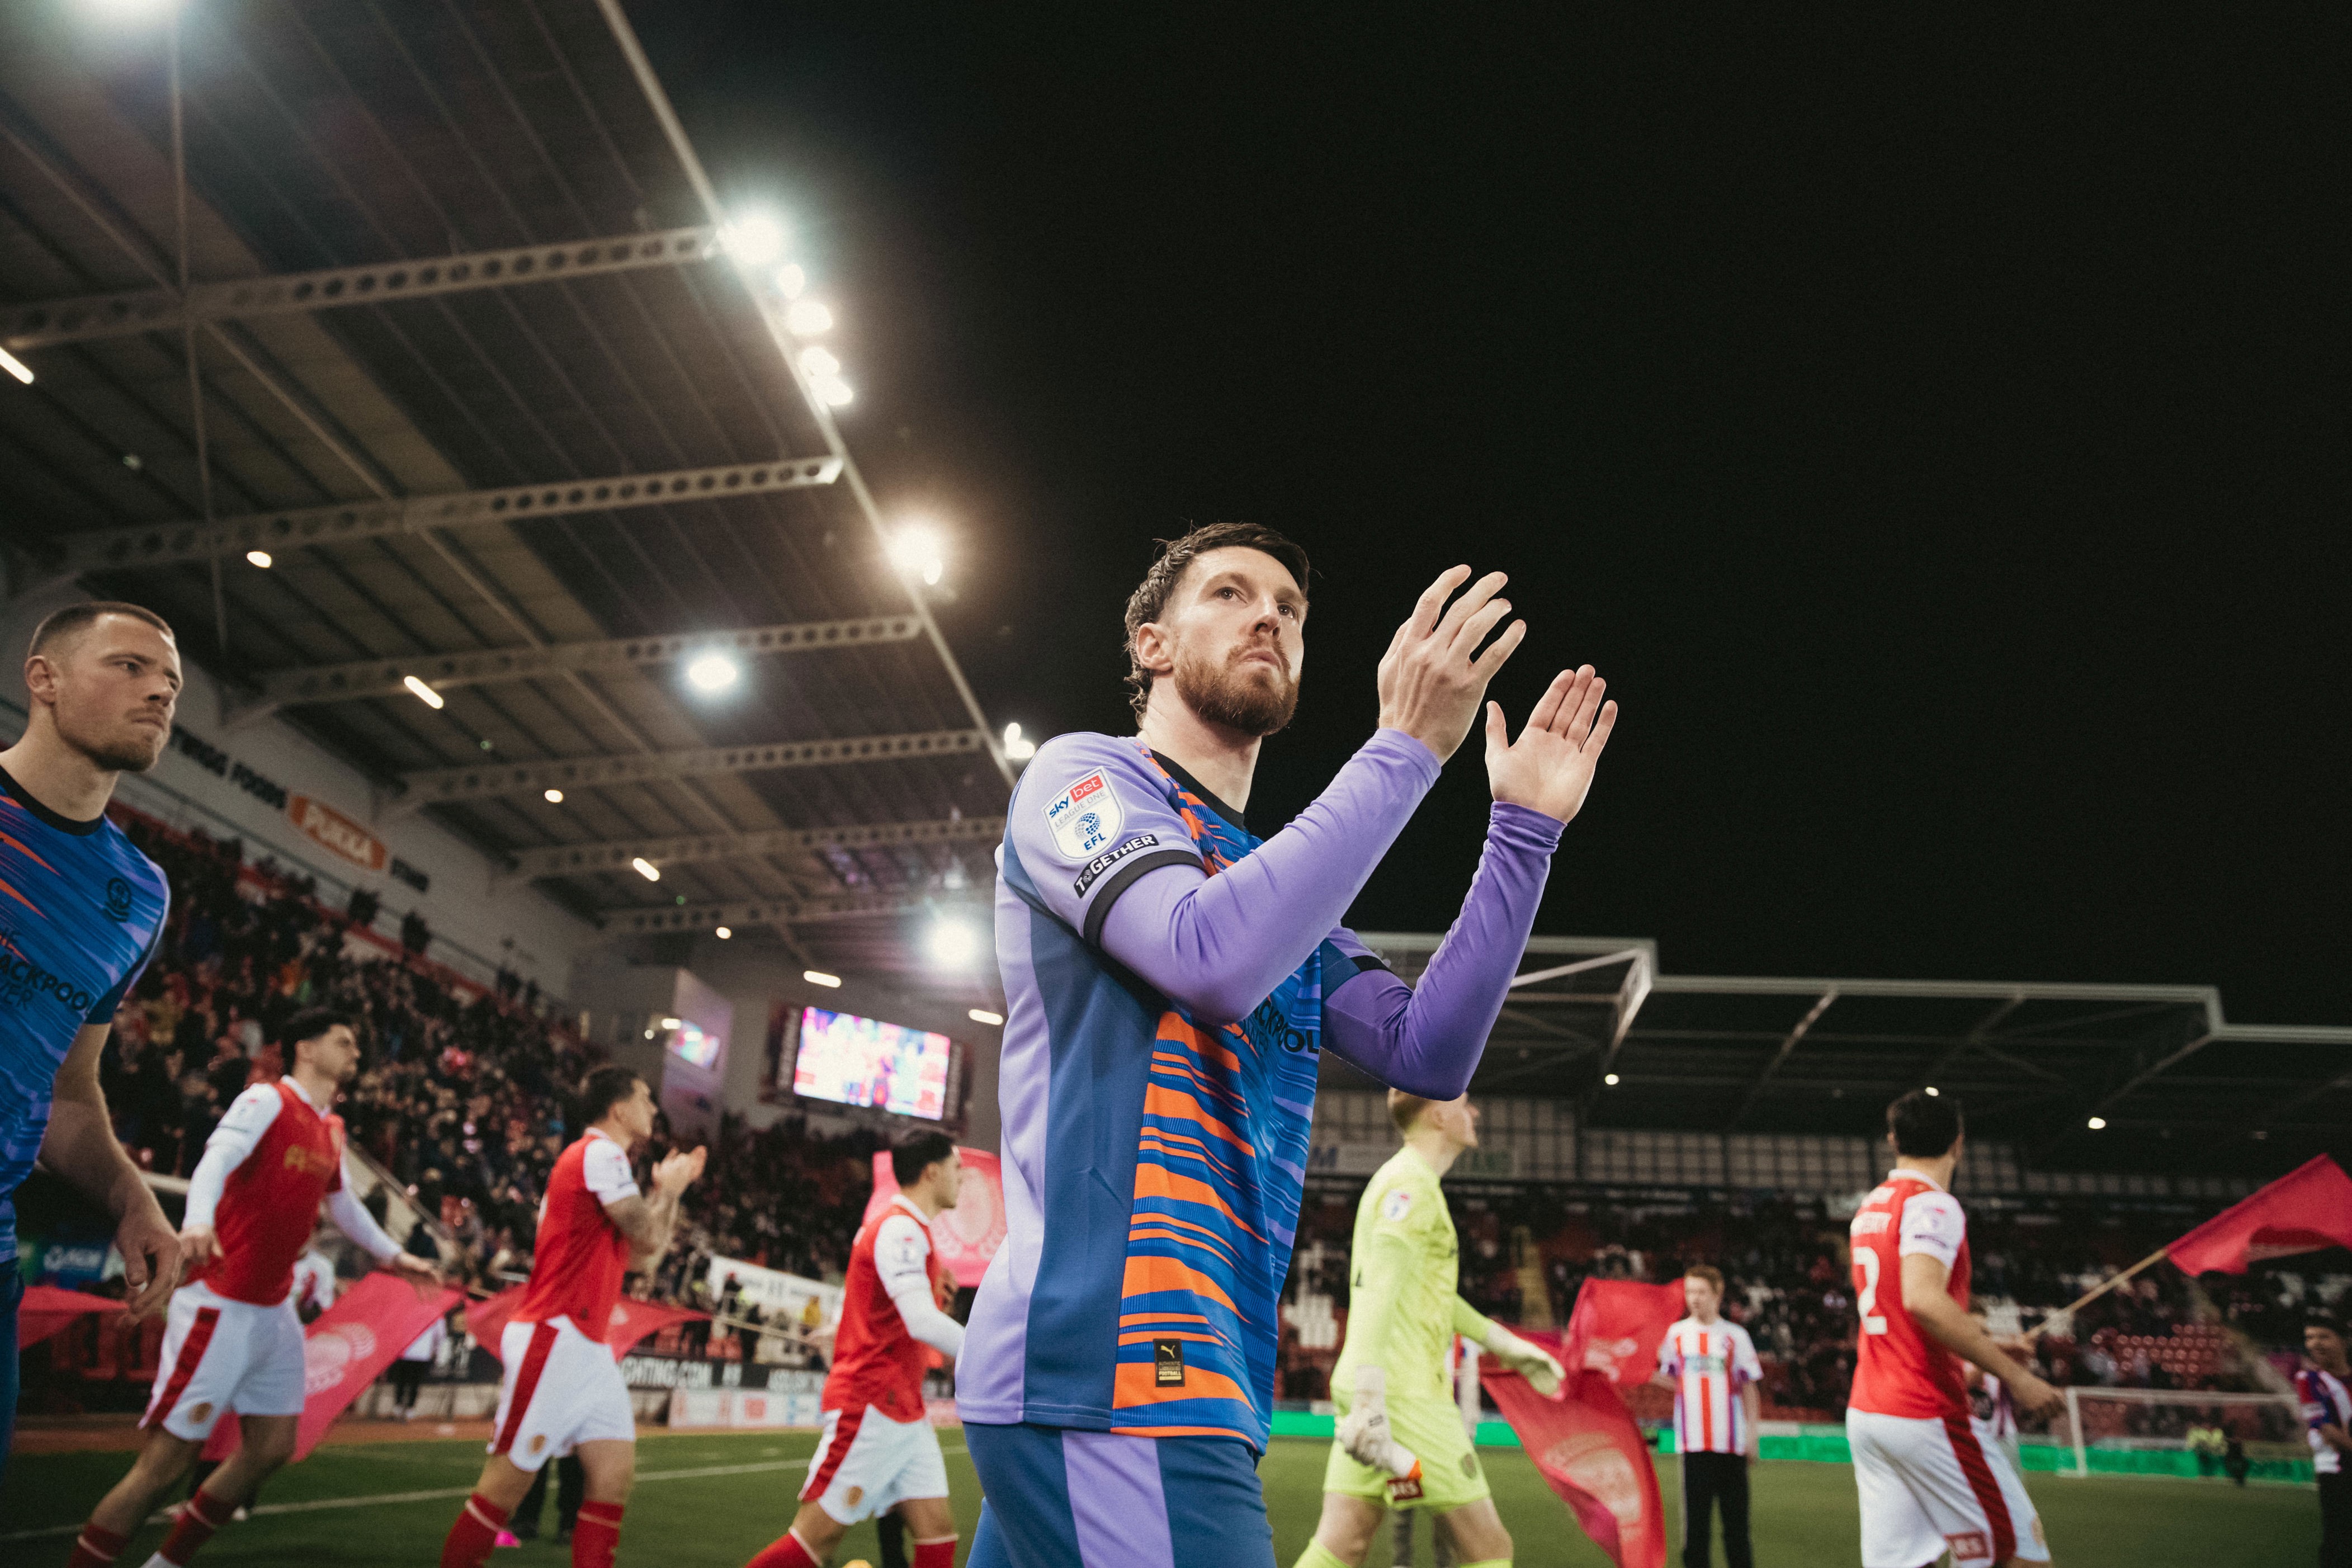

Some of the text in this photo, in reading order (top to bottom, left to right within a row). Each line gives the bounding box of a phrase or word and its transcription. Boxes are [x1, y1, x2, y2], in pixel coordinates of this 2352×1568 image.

[1049, 779, 1100, 818] sky bet
[1054, 790, 1106, 828] LEAGUE ONE
[1084, 833, 1106, 851] EFL
[1075, 835, 1156, 892] TOGETHER
[1853, 1246, 1888, 1336] 2
